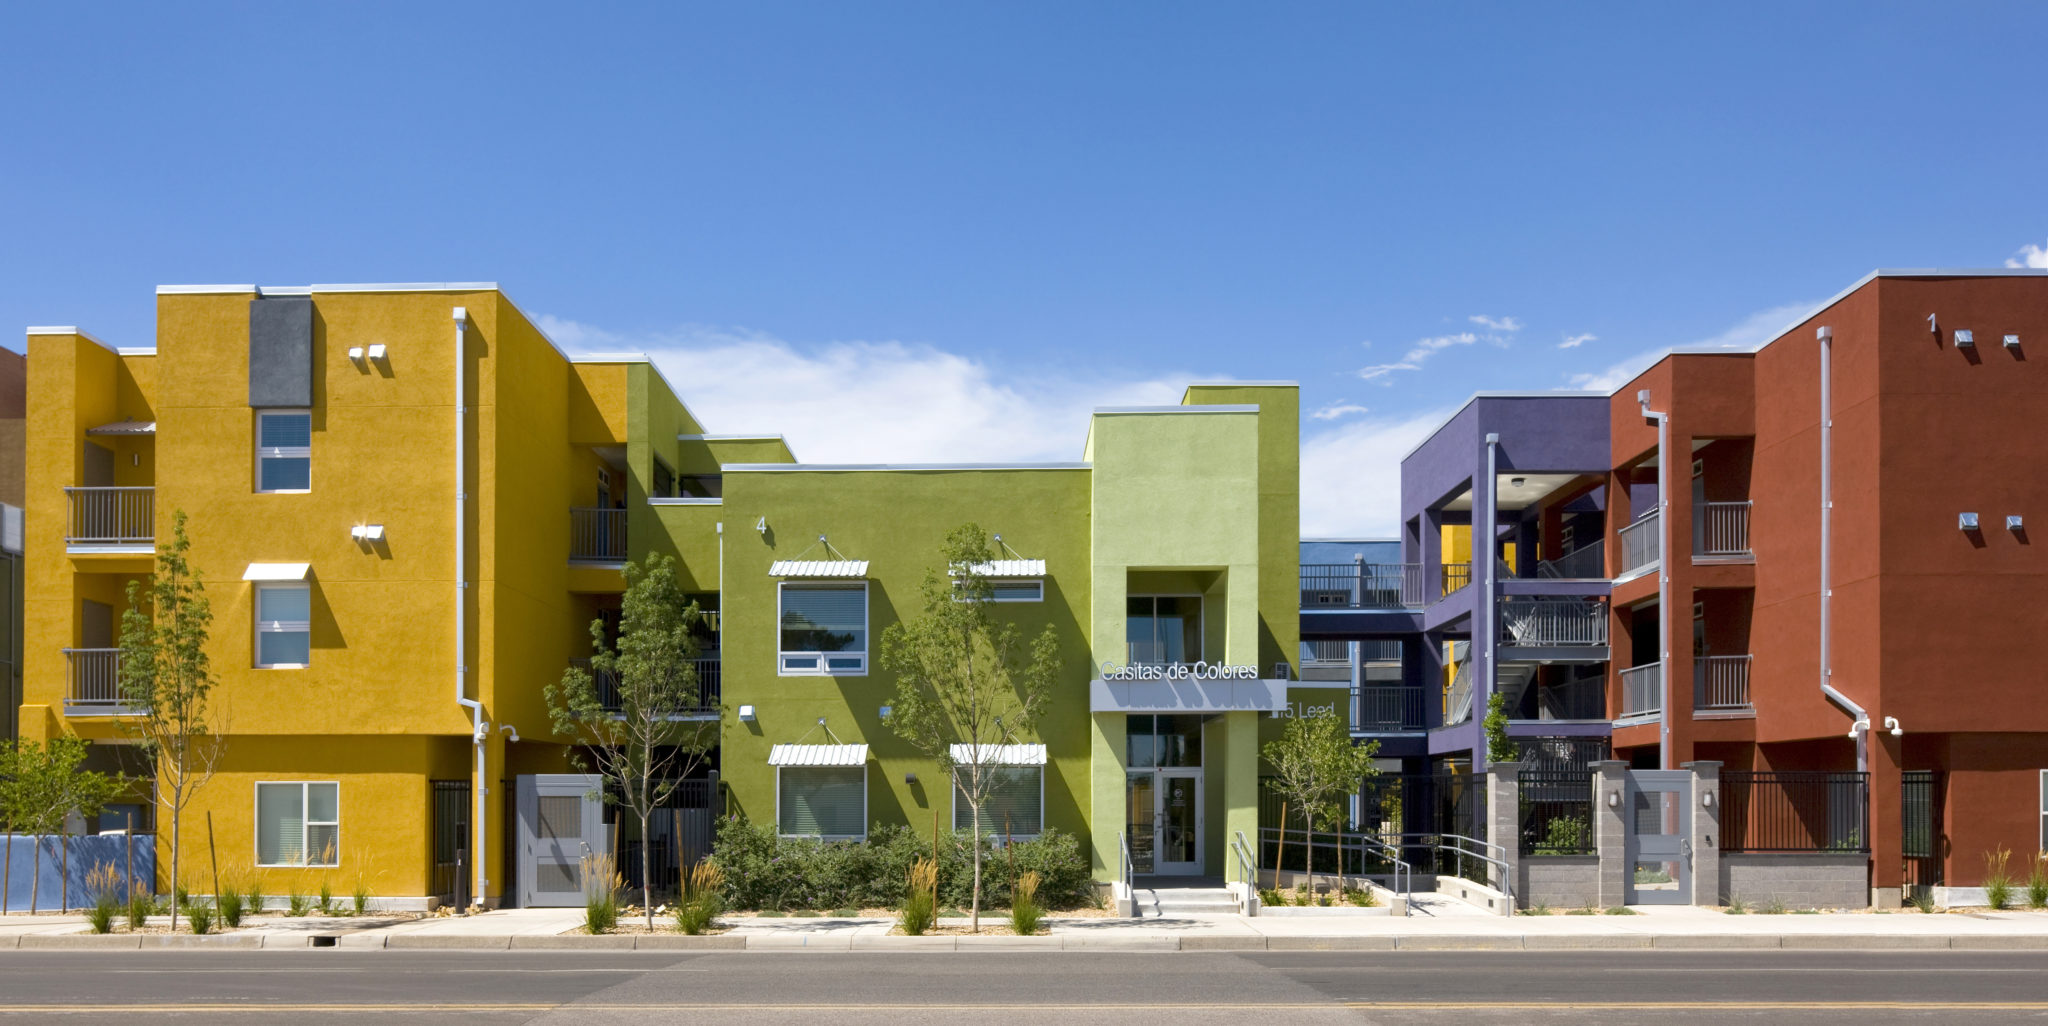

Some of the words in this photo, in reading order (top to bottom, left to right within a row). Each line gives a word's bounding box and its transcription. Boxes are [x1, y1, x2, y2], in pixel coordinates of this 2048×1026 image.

[1927, 312, 1936, 332] 1
[756, 516, 767, 534] 4
[1101, 661, 1162, 681] Casitas
[1167, 661, 1189, 680] de
[1194, 661, 1258, 680] Colores
[1299, 701, 1336, 719] Lead
